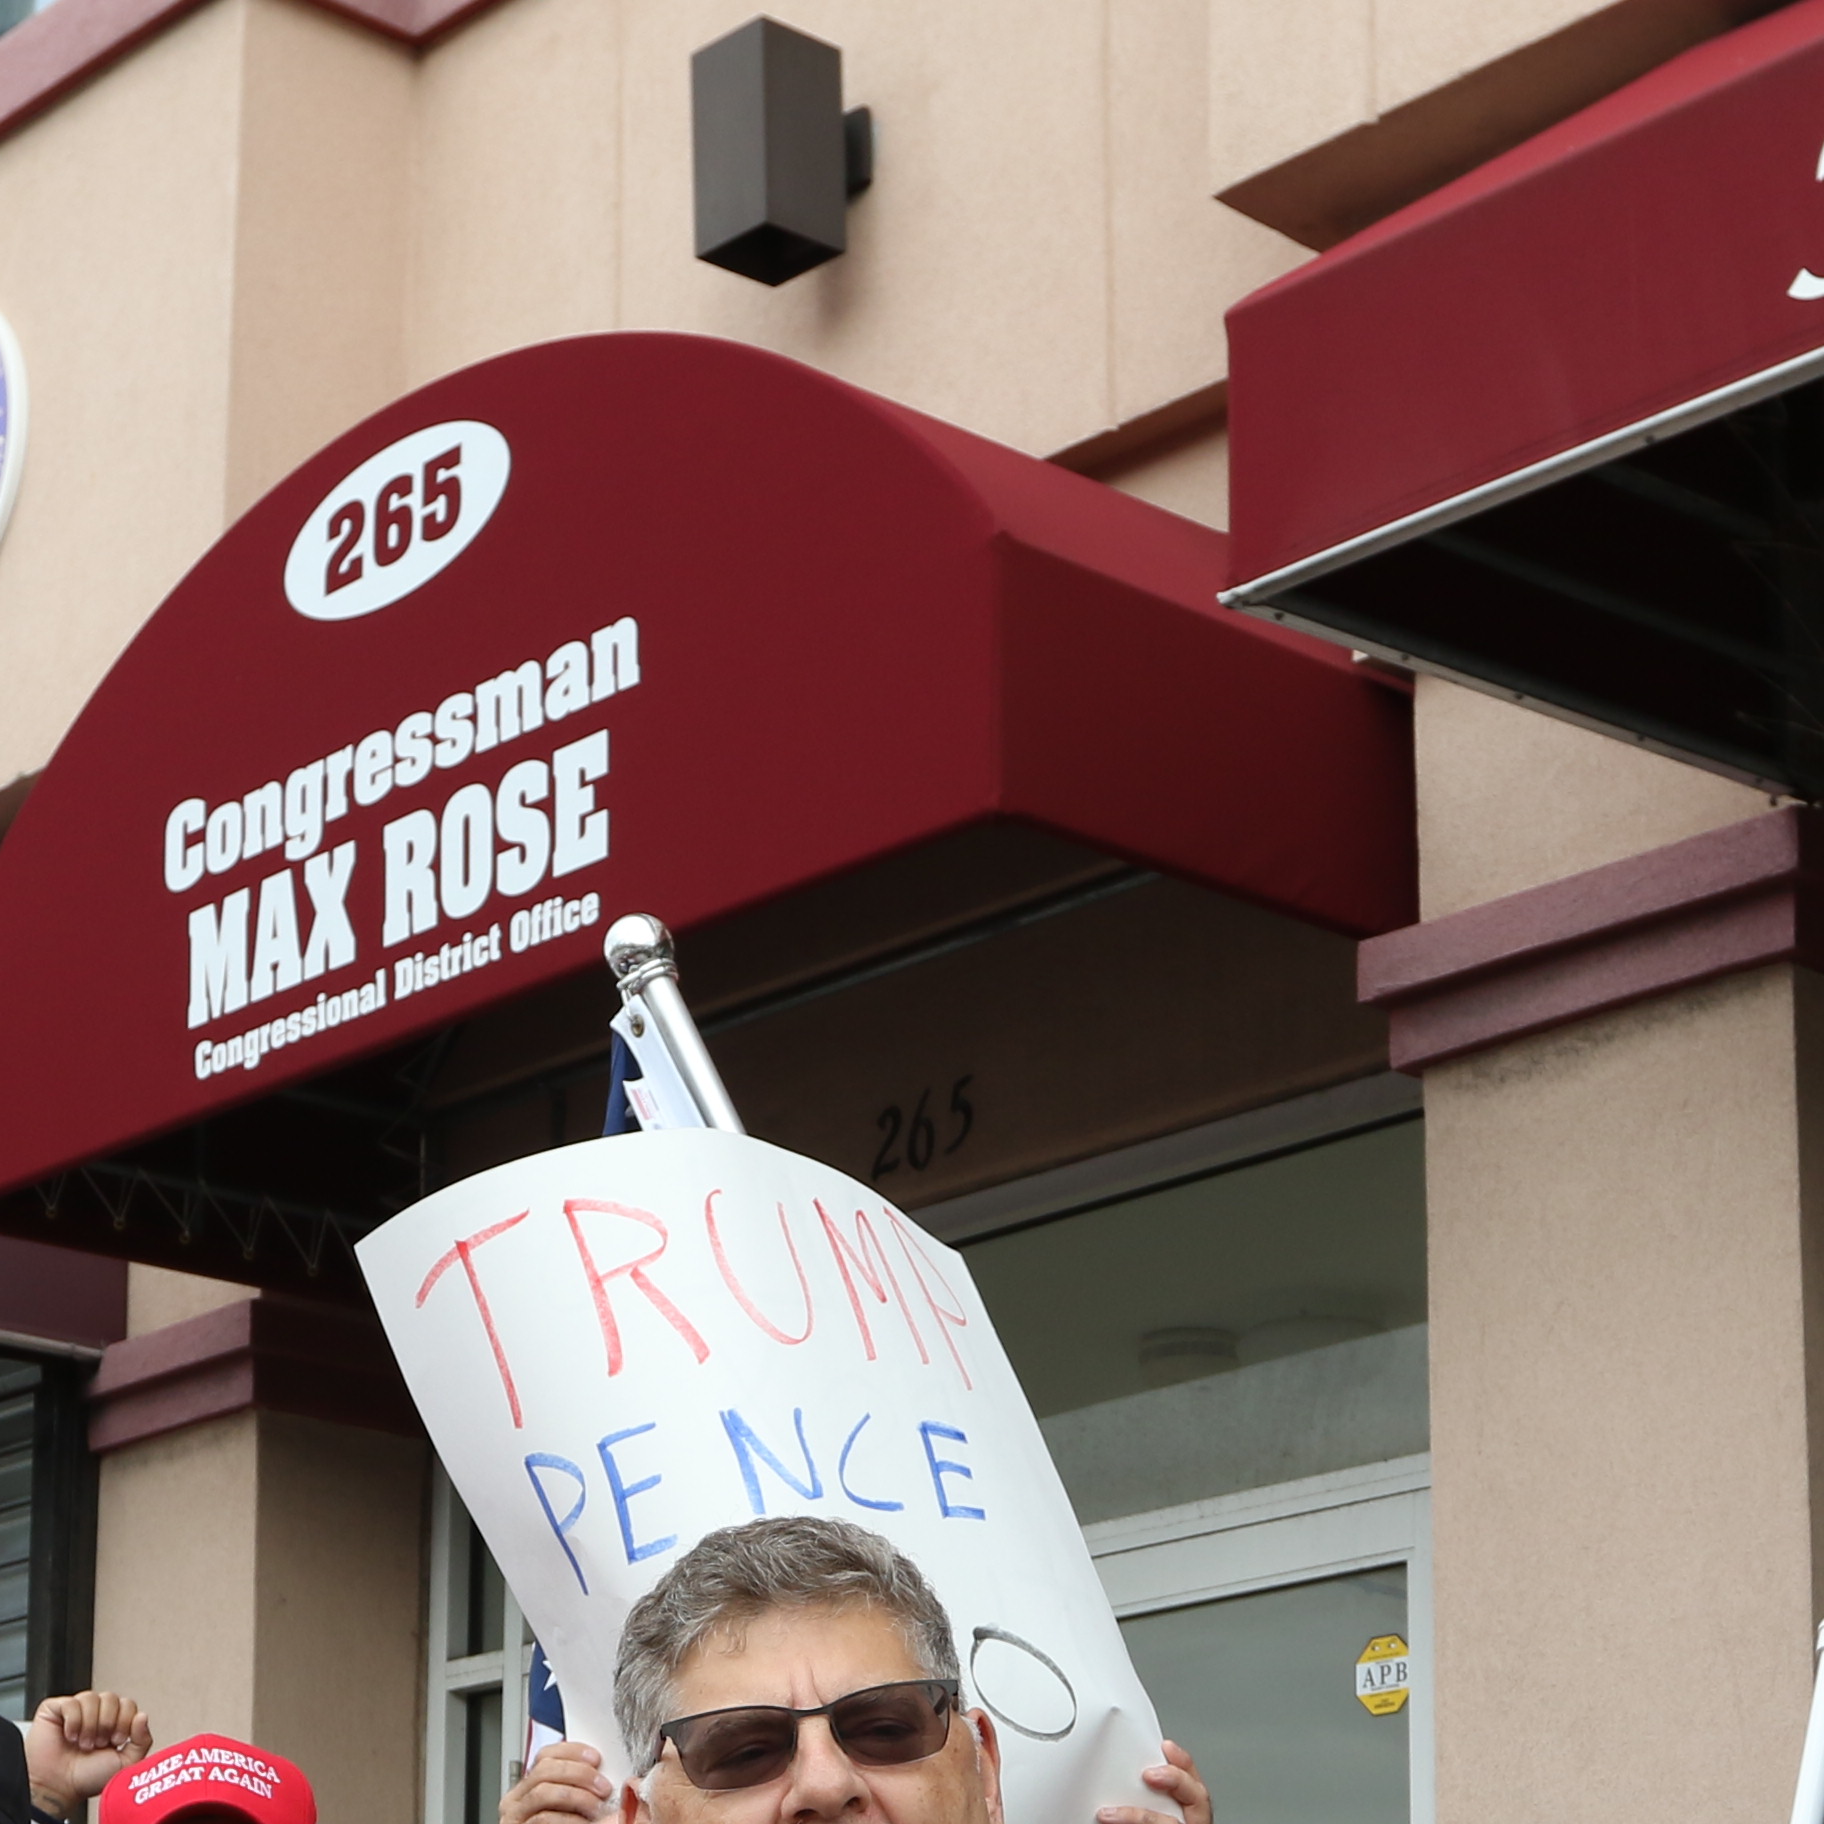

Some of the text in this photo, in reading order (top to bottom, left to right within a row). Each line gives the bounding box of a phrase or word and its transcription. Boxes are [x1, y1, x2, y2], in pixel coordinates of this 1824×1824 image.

[323, 443, 463, 598] 265
[164, 616, 641, 893] Congressman
[187, 728, 609, 1030] MAX ROSE
[194, 891, 600, 1080] Congressional District Office
[871, 1073, 974, 1181] 265
[415, 1189, 973, 1430] TRUMP
[524, 1407, 986, 1596] PENCE
[1362, 1661, 1408, 1689] APB
[128, 1748, 281, 1790] MAKE AMERICA
[134, 1766, 272, 1804] GREAT AGAIN
